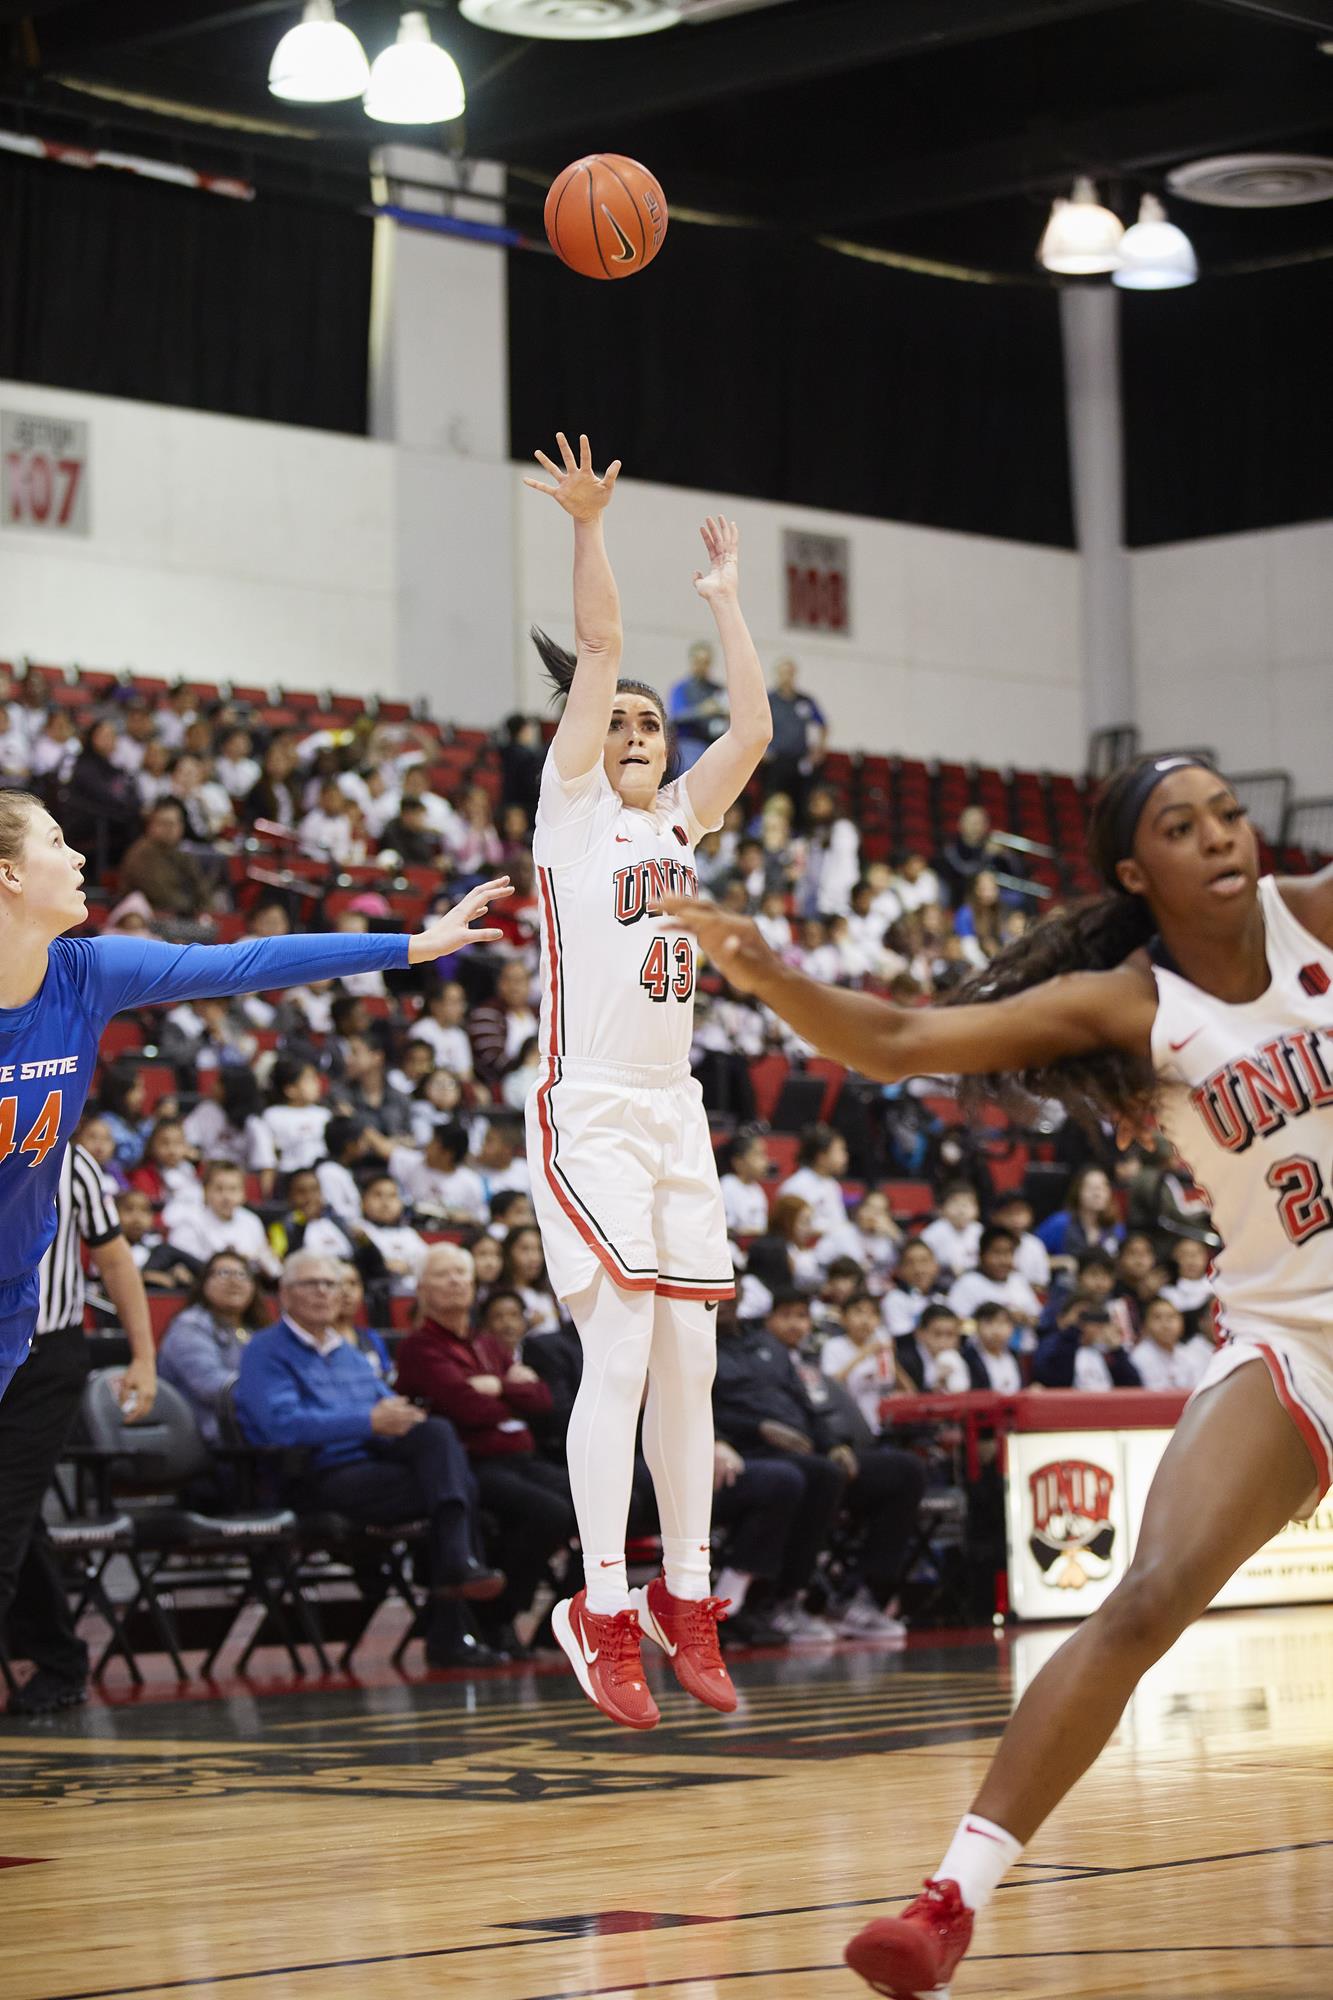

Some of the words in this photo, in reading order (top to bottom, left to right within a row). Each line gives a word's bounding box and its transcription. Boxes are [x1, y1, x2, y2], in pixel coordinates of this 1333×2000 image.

[640, 937, 693, 1003] 43
[20, 1055, 79, 1080] STATE
[1192, 1026, 1333, 1153] UNL
